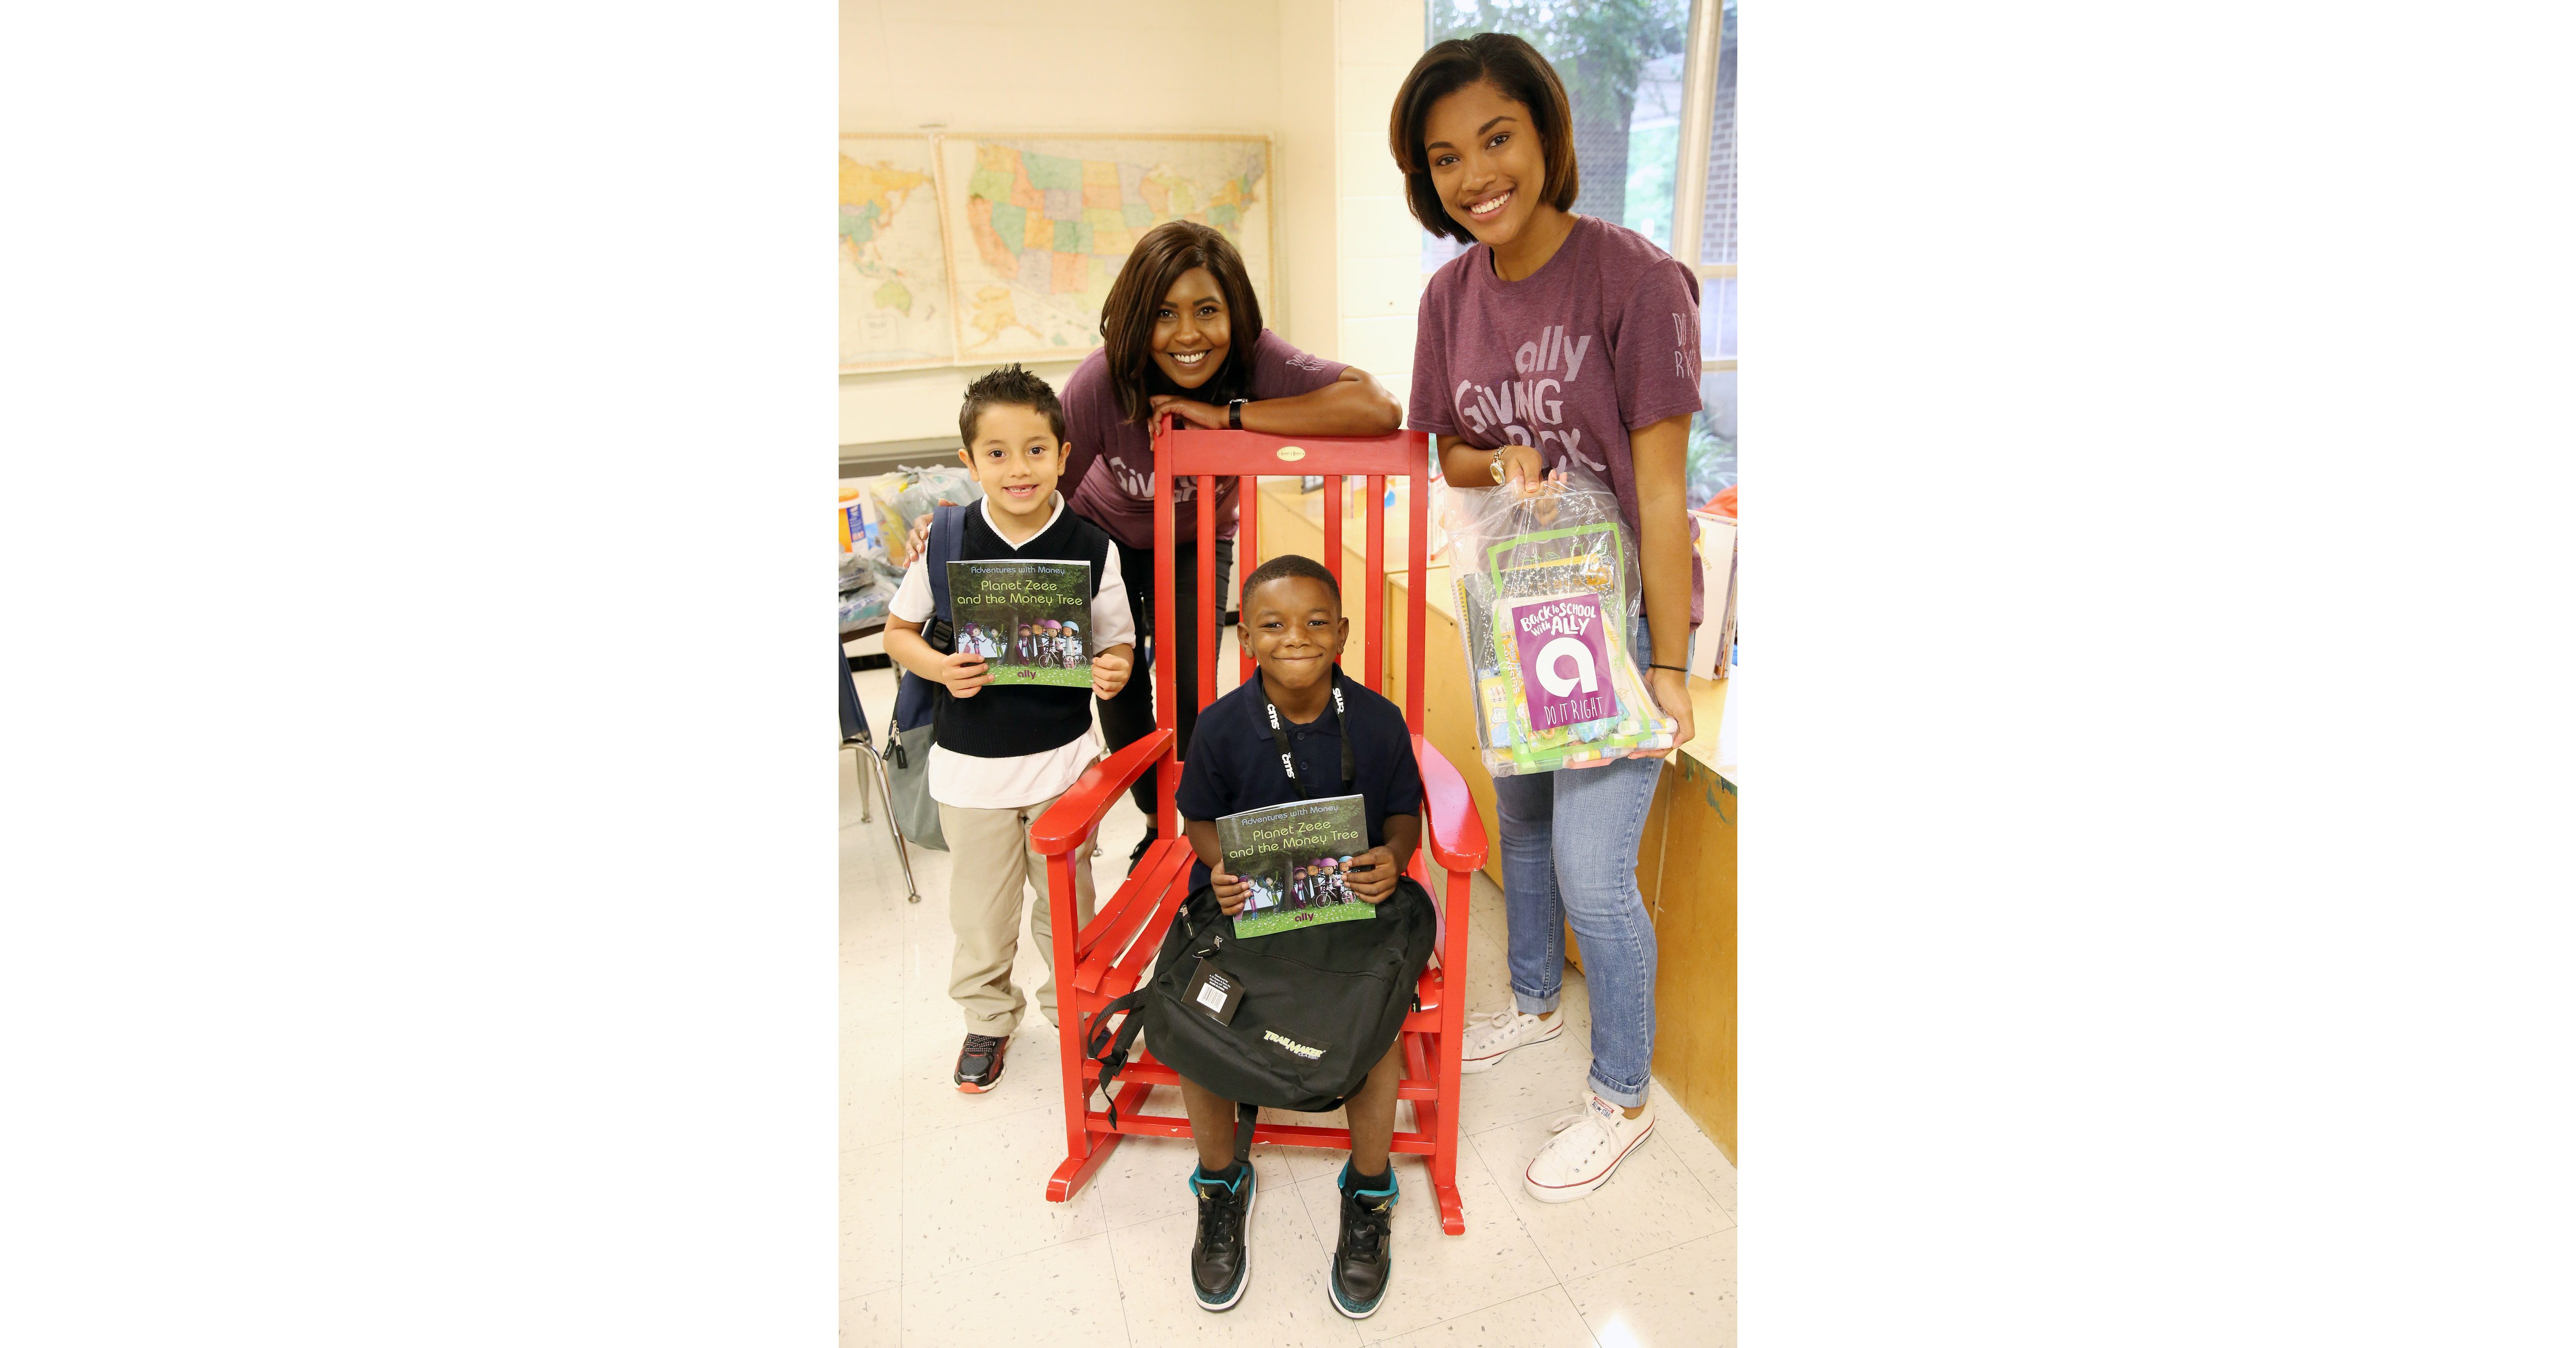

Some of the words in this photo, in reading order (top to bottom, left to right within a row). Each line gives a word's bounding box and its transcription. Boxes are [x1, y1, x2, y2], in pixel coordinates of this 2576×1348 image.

[1516, 325, 1591, 382] ally
[1038, 566, 1065, 576] Money
[981, 580, 1022, 590] Planet
[1025, 580, 1057, 590] Zeee
[957, 594, 981, 604] and
[986, 593, 1006, 604] the
[1010, 593, 1052, 606] Money
[1056, 594, 1082, 605] Tree
[1550, 604, 1559, 614] to
[1559, 602, 1596, 618] SCHOOL
[1550, 614, 1590, 636] ALLY
[1017, 670, 1036, 679] ally
[1544, 705, 1556, 726] DO
[1559, 703, 1568, 723] IT
[1242, 813, 1288, 826] Adventures
[1310, 805, 1339, 814] Money
[1253, 825, 1294, 841] Planet
[1298, 821, 1331, 833] Zeee
[1229, 845, 1254, 859] and
[1258, 843, 1279, 853] the
[1283, 835, 1327, 849] Money
[1331, 831, 1359, 841] Tree
[1295, 912, 1314, 921] ally
[1600, 1108, 1611, 1118] STAR
